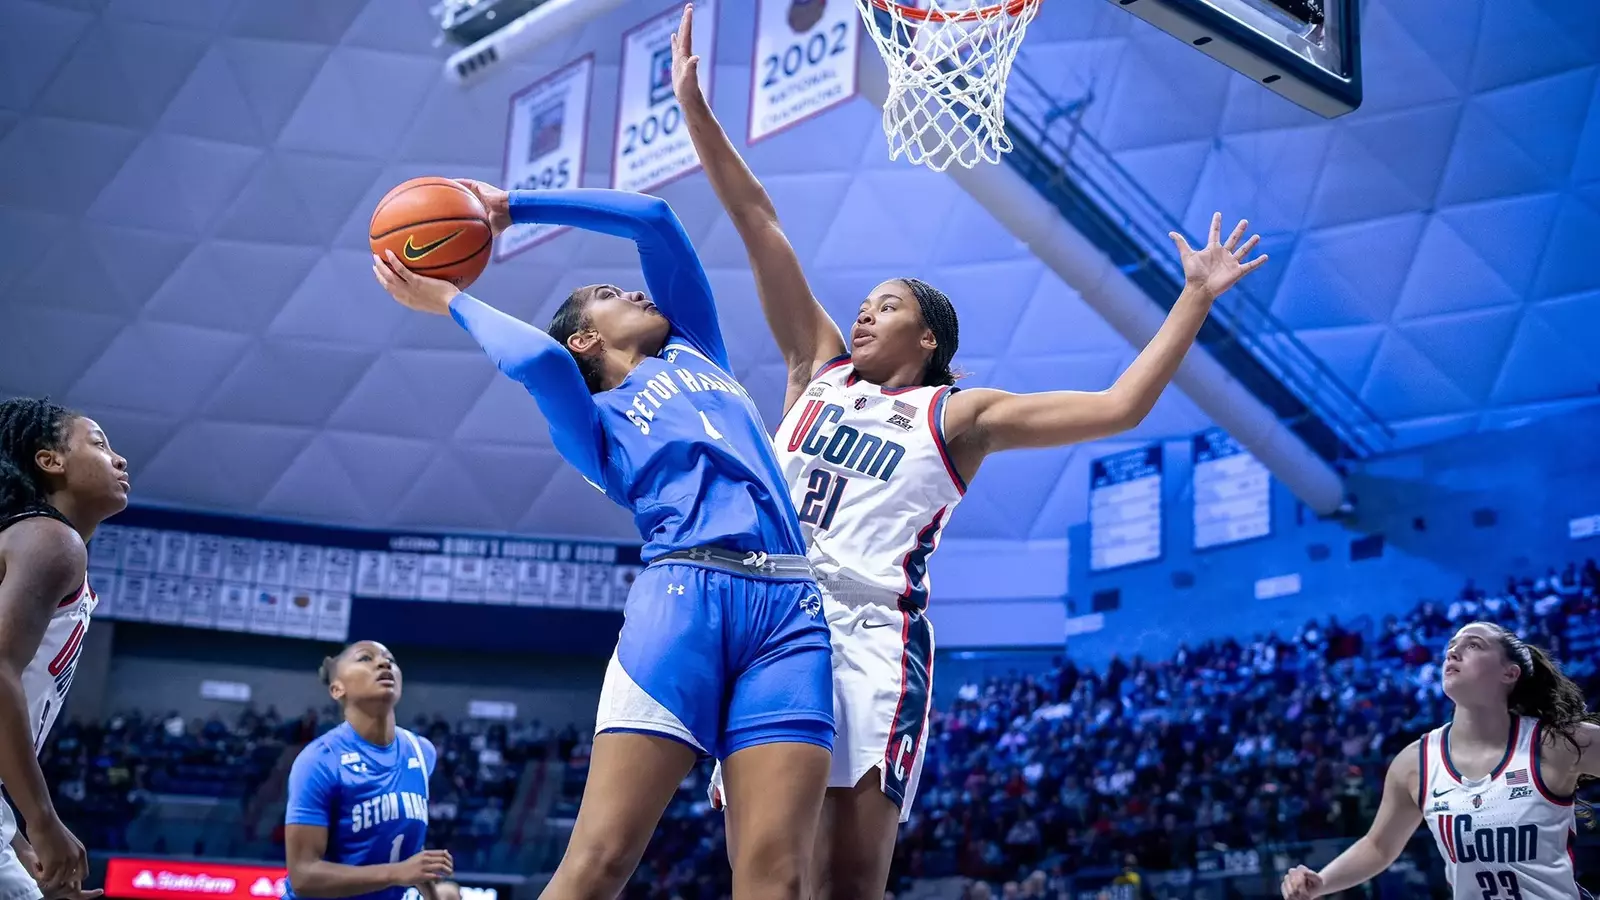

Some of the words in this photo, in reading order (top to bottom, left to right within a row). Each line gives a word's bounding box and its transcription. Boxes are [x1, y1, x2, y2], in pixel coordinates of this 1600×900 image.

[763, 21, 847, 88] 2002
[622, 104, 681, 156] 200
[625, 371, 681, 435] SETON
[886, 418, 914, 432] EAST
[787, 400, 906, 482] UConn
[799, 468, 848, 532] 21
[352, 792, 399, 833] SETON
[1509, 790, 1533, 800] EAST
[389, 834, 404, 864] 1
[1438, 814, 1538, 864] UConn
[1475, 870, 1522, 900] 23
